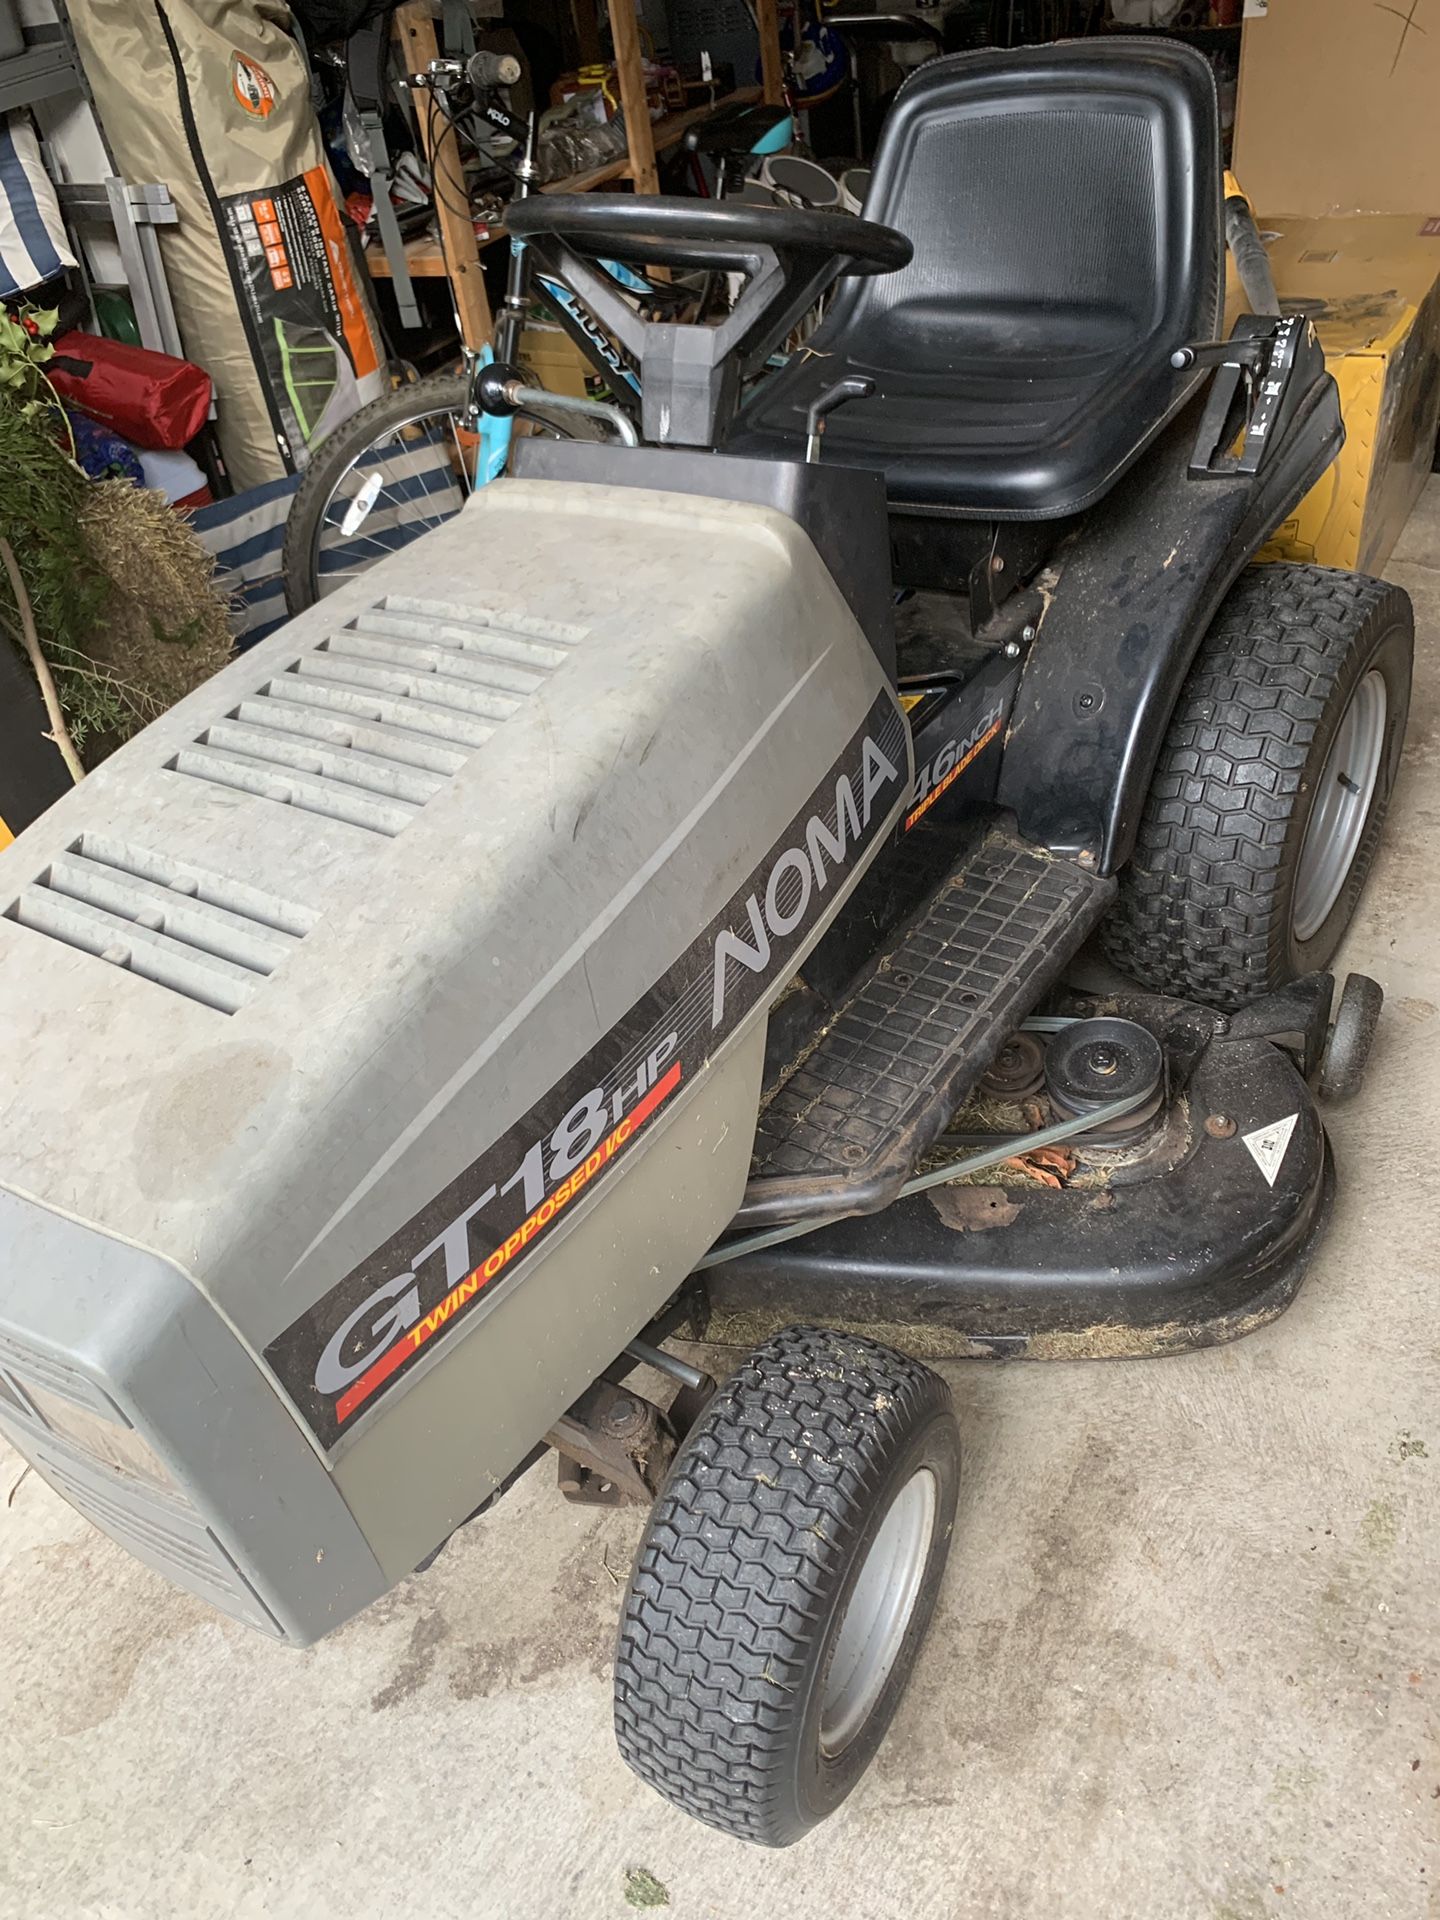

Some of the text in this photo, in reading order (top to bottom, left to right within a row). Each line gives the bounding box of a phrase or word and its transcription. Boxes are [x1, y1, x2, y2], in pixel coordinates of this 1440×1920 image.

[908, 724, 998, 824] TRIPLE BLADE DECK
[711, 735, 898, 1030] NOMA
[406, 1272, 478, 1348] TWIN
[484, 1152, 601, 1277] OPPOSED
